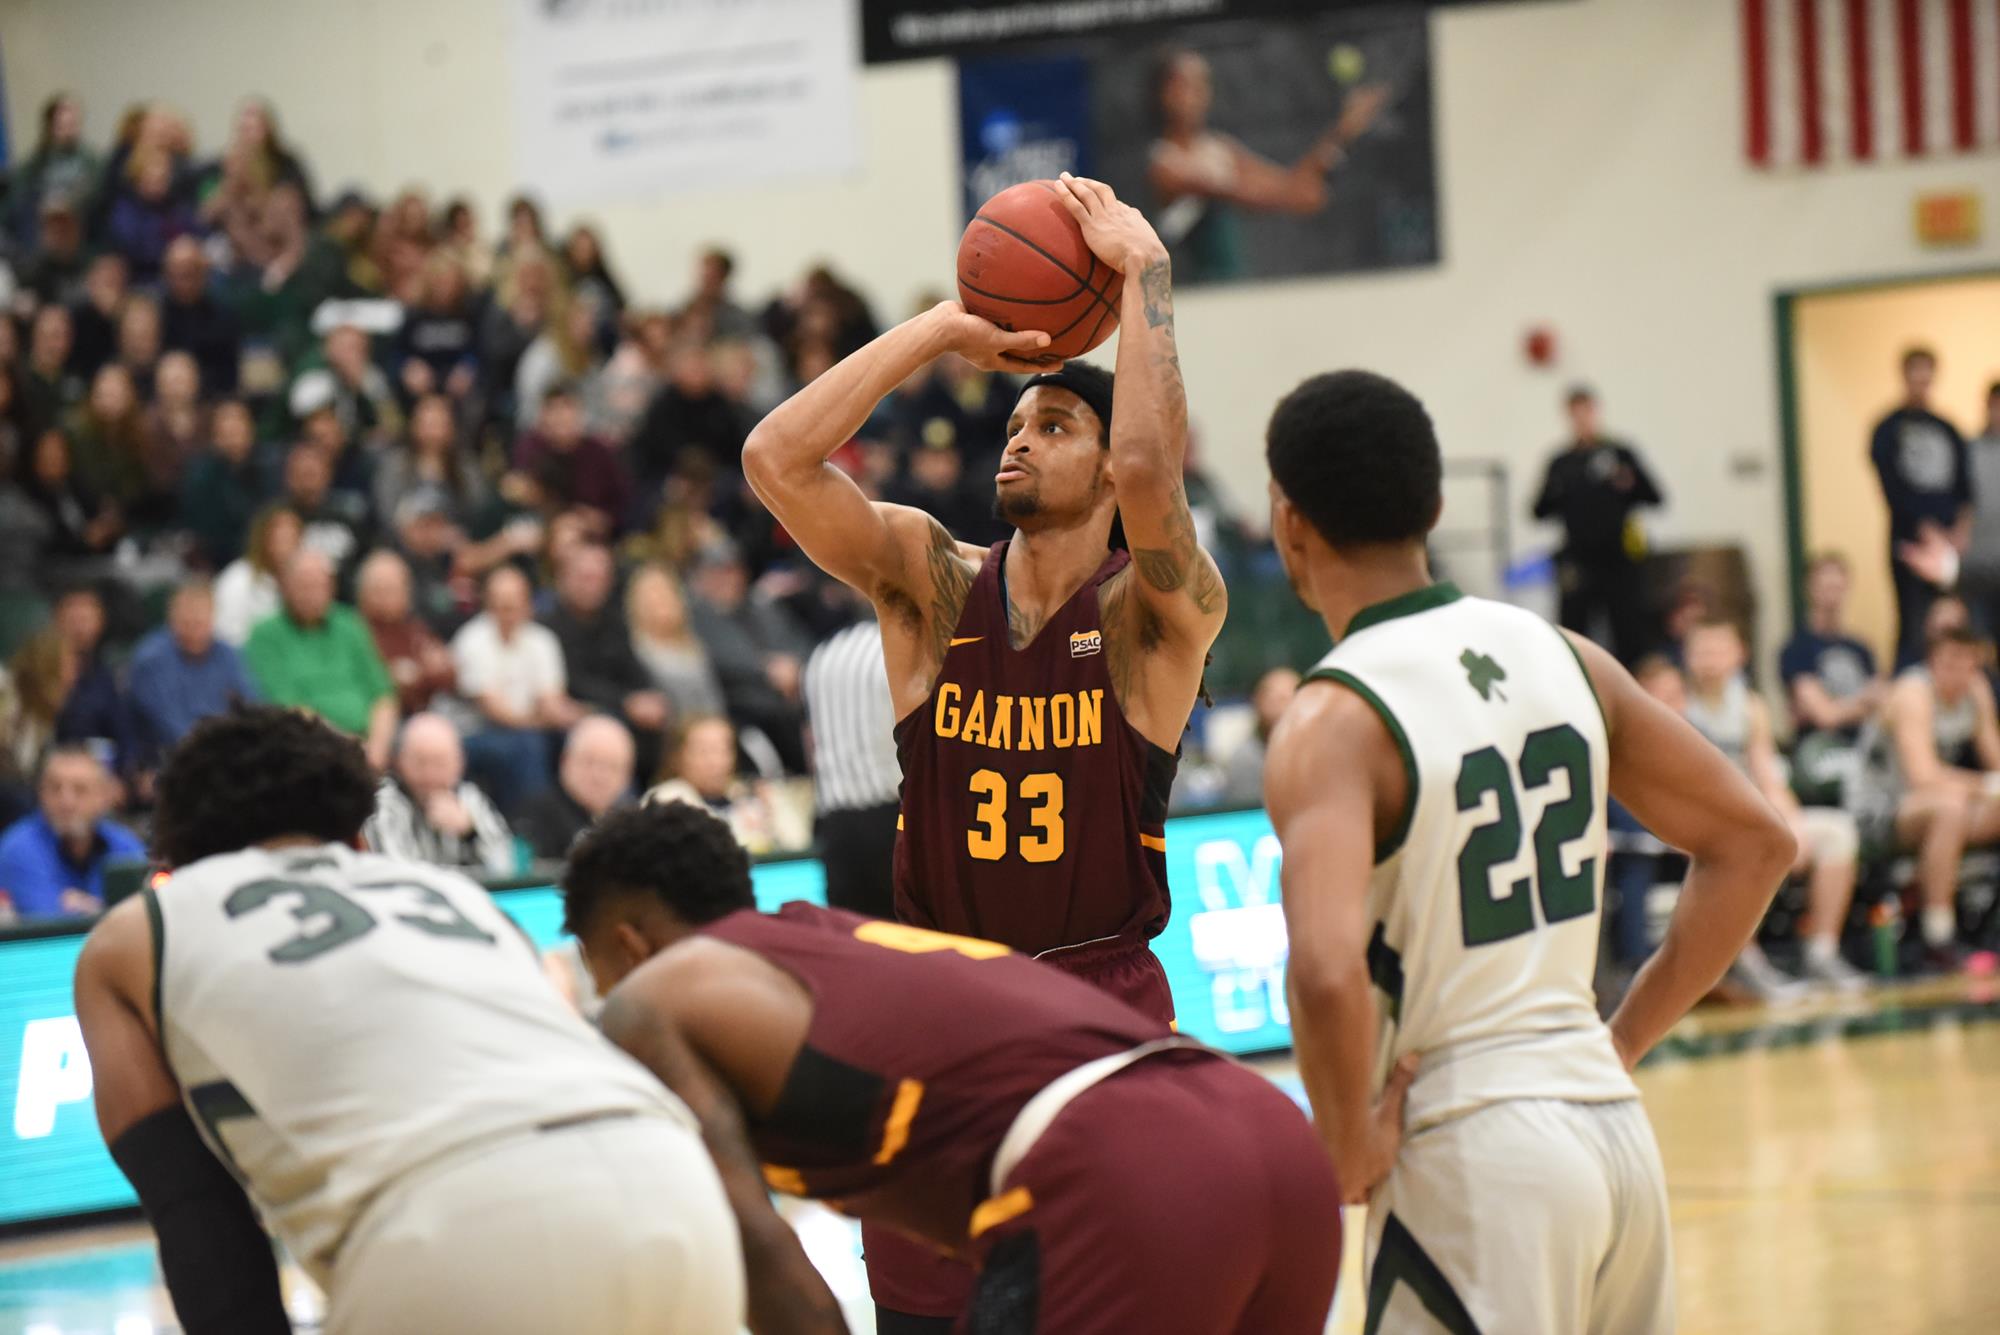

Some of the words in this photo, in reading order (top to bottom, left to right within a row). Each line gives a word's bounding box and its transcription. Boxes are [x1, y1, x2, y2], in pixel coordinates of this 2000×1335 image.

[1072, 637, 1100, 650] PSAC
[934, 682, 1104, 751] GANNON
[967, 768, 1064, 863] 33
[1456, 723, 1599, 948] 22
